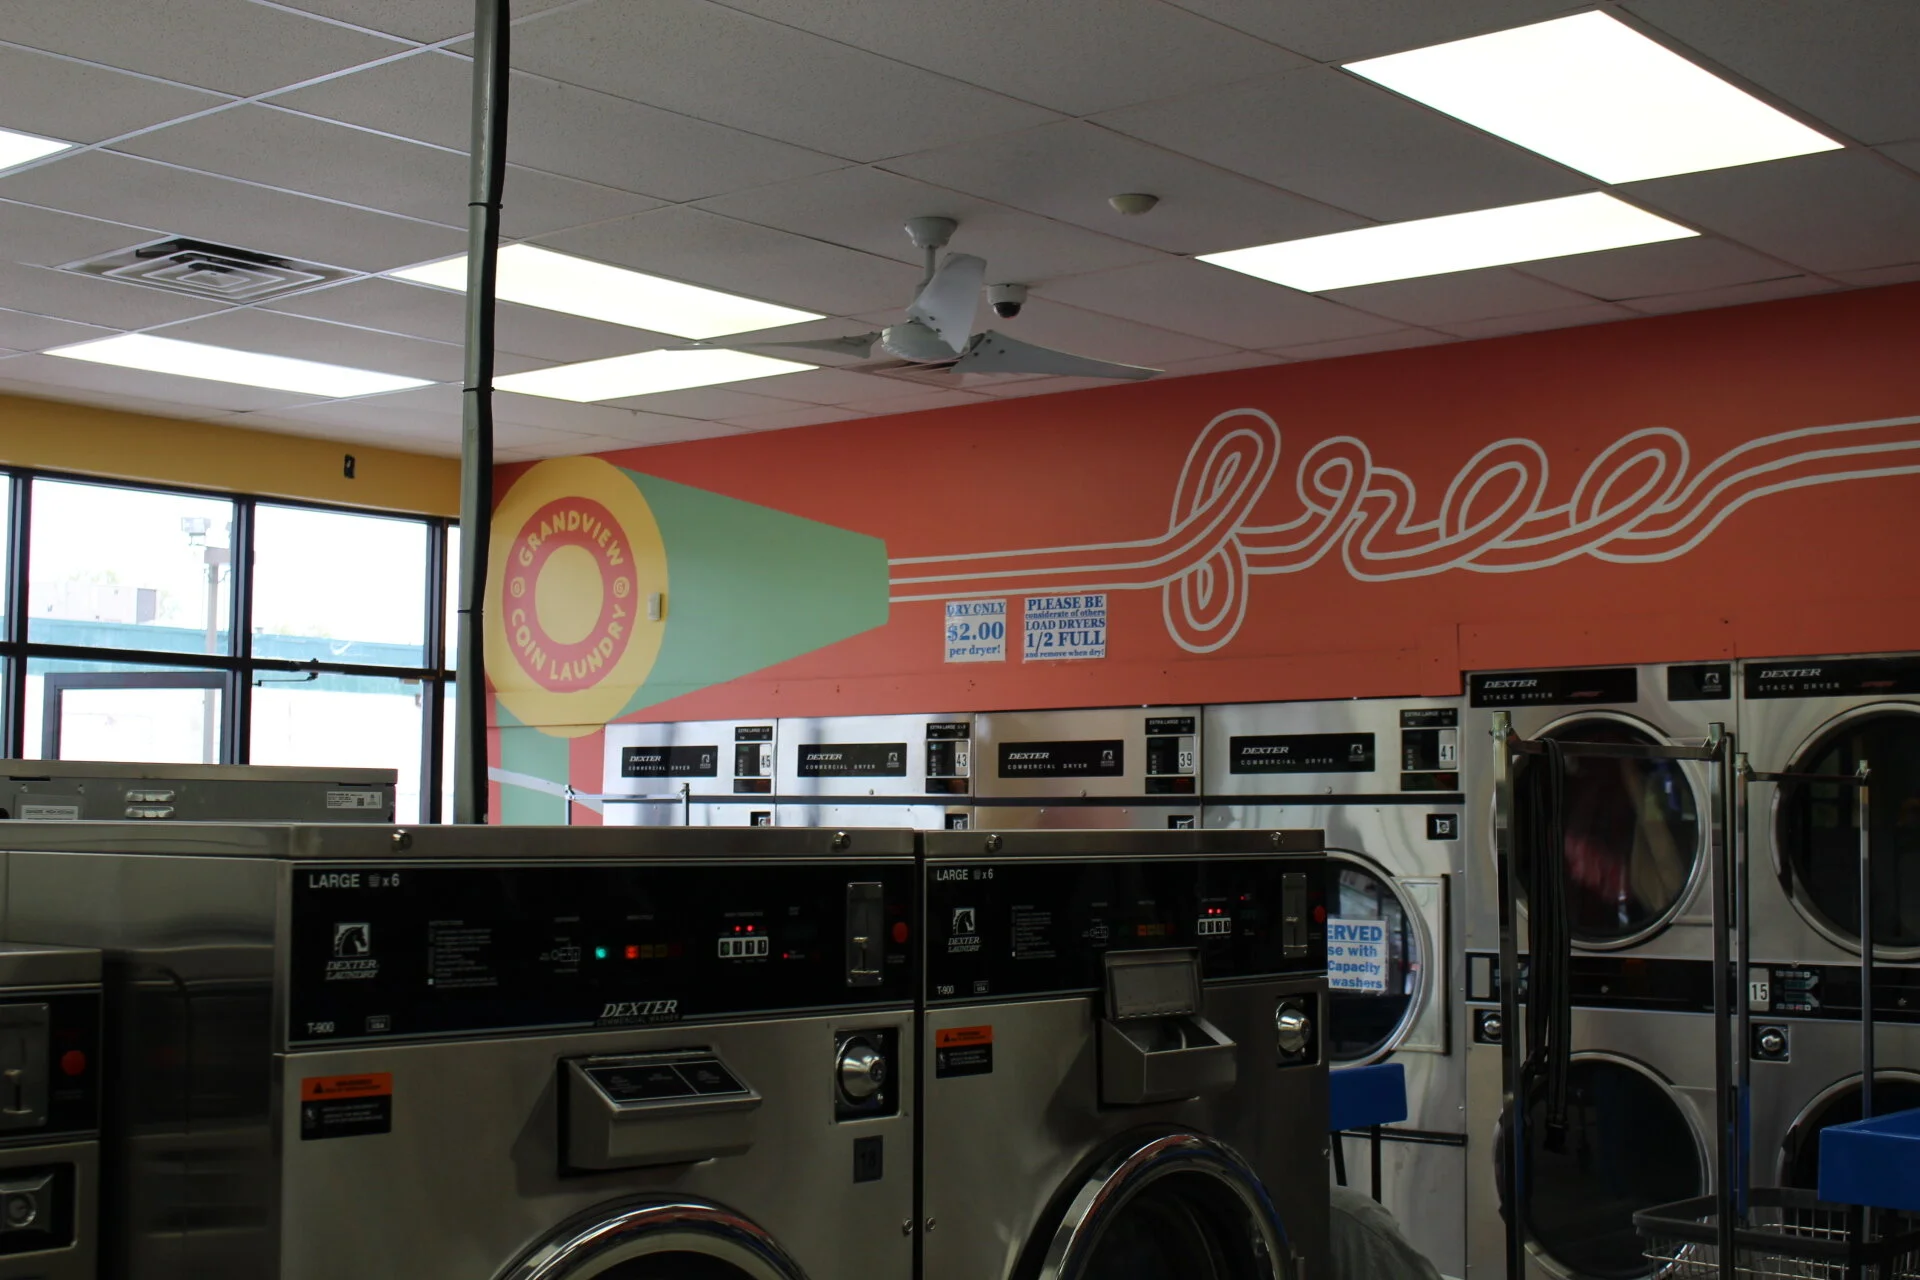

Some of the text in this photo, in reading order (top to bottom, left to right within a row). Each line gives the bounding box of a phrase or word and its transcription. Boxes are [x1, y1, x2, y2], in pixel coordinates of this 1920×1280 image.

[519, 510, 624, 567] GRANDVIEW
[947, 602, 1006, 615] DRY ONLY
[1028, 596, 1103, 611] PLEASE BE
[1025, 609, 1105, 619] considerate of others
[1025, 618, 1105, 631] LOAD DRYERS
[947, 621, 1004, 642] $2.00
[512, 604, 626, 681] COIN LAUNDRY
[1027, 631, 1104, 653] 1/2 FULL
[949, 645, 1001, 658] per dryer!
[1759, 668, 1822, 679] DEXTER
[1483, 679, 1538, 689] DEXTER
[1758, 682, 1840, 692] STACK DRYER
[806, 753, 843, 761] DEXTER
[1008, 752, 1050, 760] DEXTER
[1241, 746, 1289, 755] DEXTER
[1440, 745, 1454, 761] 41
[761, 755, 771, 768] 45
[956, 752, 967, 768] 43
[1179, 753, 1193, 768] 39
[309, 874, 361, 889] LARGE
[936, 869, 969, 881] LARGE
[947, 936, 981, 946] DEXTER
[1347, 945, 1377, 957] with
[325, 959, 378, 971] DEXTER
[1328, 960, 1380, 975] Capacity
[1331, 976, 1383, 989] washers
[936, 985, 955, 995] T-900
[1752, 984, 1768, 1000] 15
[600, 1000, 678, 1018] DEXTER
